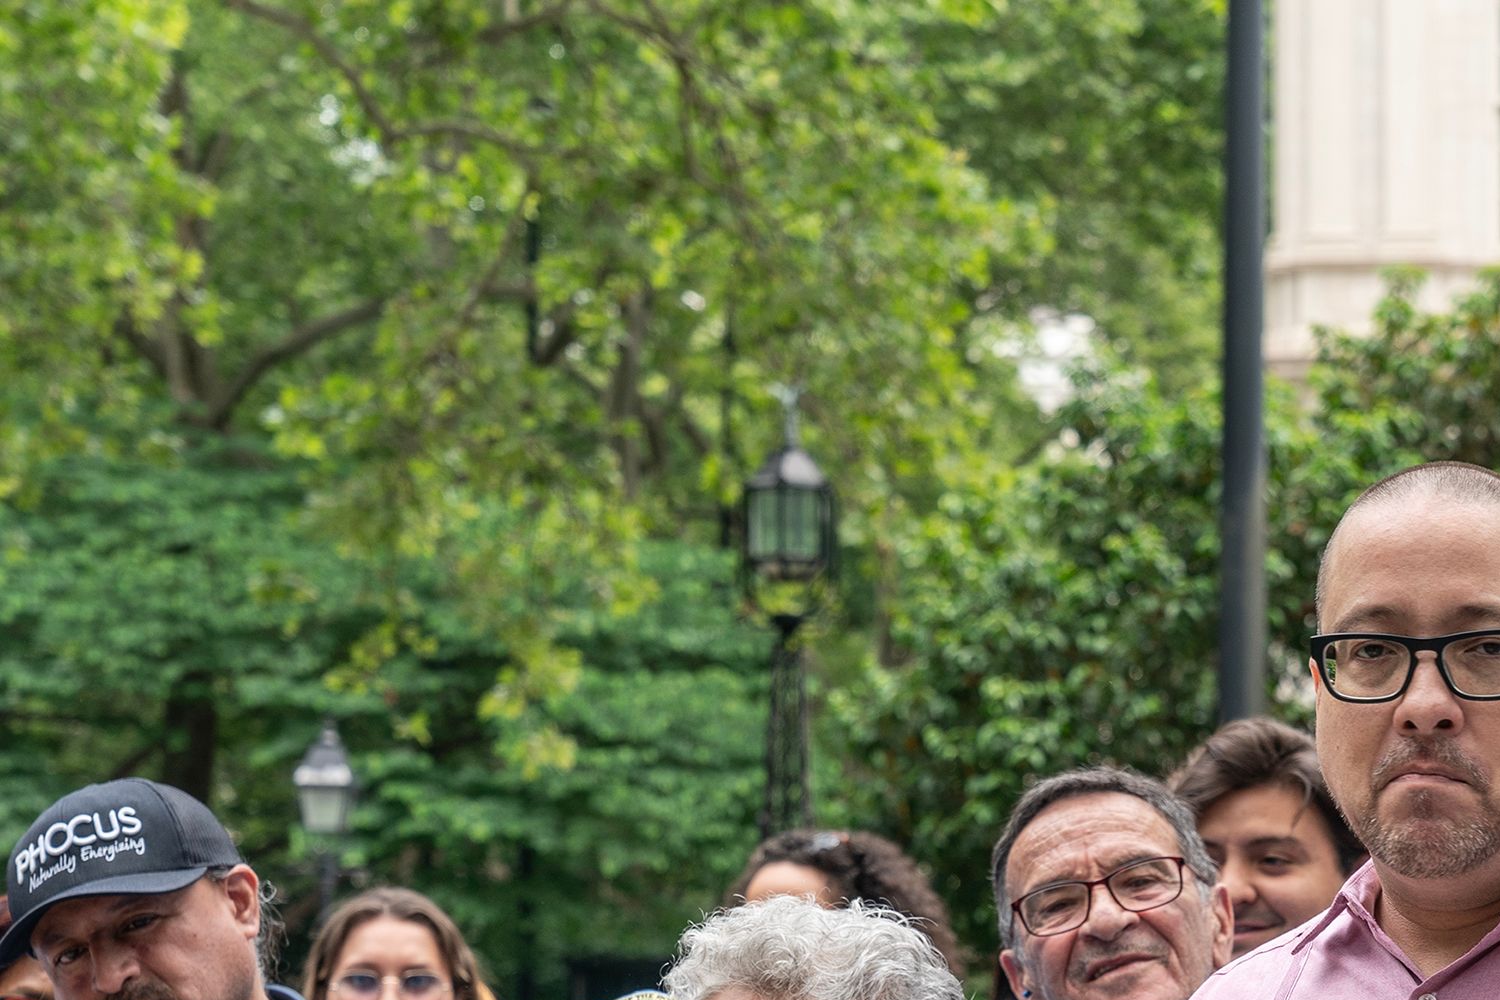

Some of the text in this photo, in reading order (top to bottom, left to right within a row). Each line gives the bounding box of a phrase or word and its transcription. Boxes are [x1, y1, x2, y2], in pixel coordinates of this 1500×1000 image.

[15, 806, 142, 885] PHOCUS
[29, 837, 145, 894] Naturally Energizing
